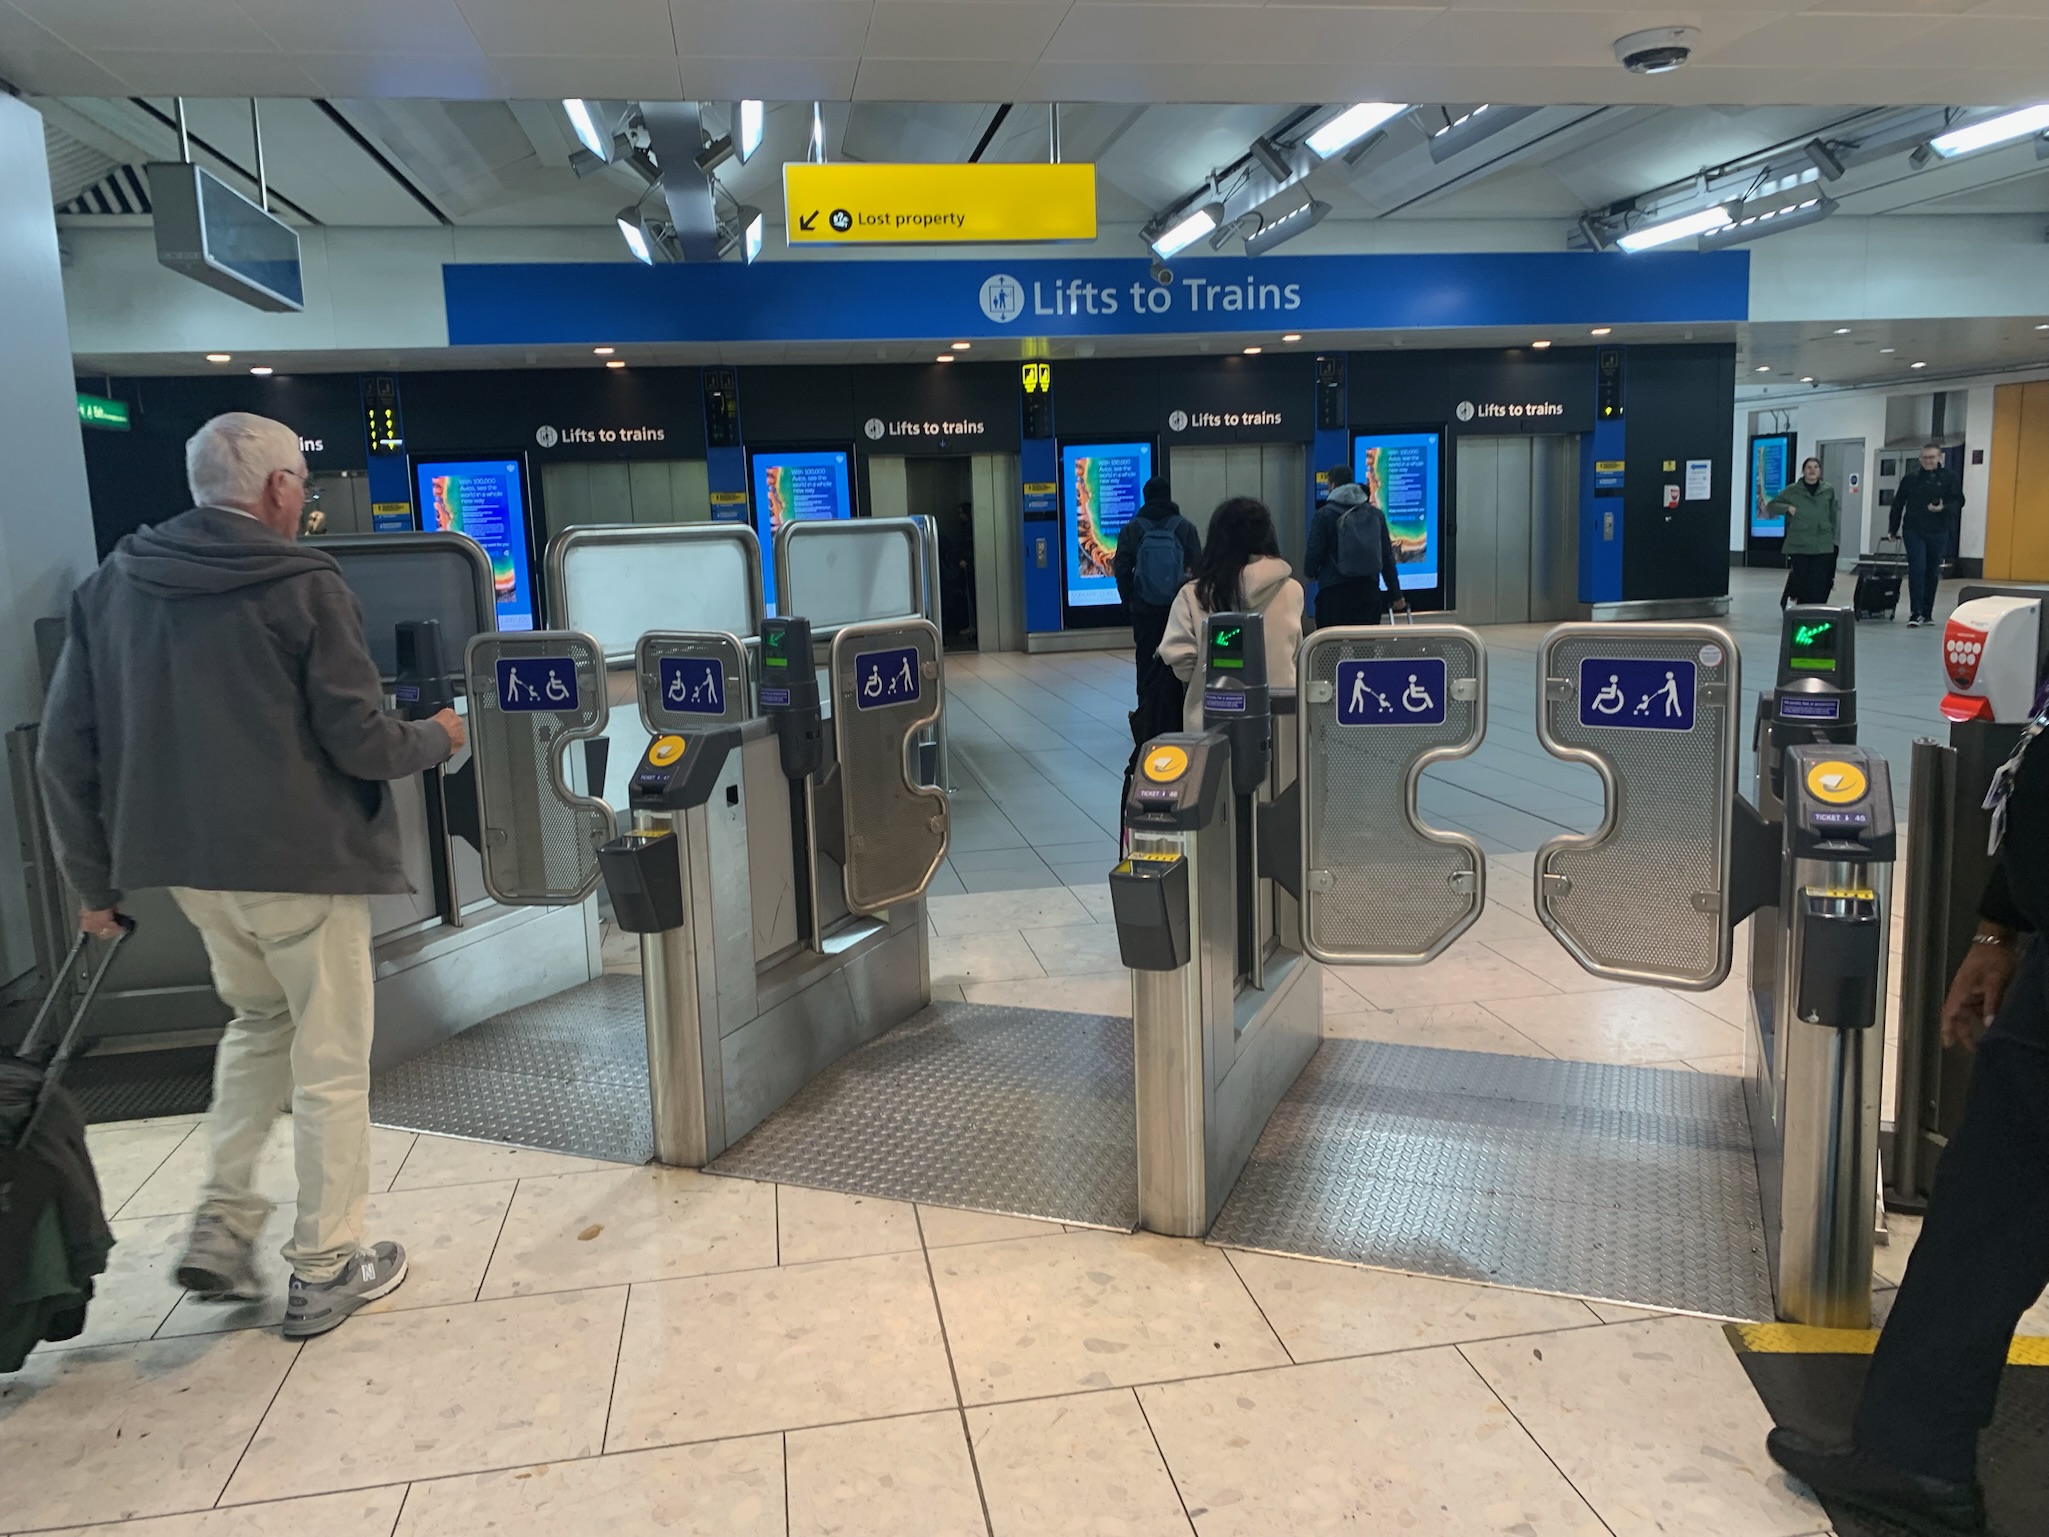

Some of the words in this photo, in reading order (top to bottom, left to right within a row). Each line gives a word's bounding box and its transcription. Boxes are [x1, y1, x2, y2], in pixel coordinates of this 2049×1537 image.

[859, 212, 890, 226] Lost
[896, 214, 965, 228] property
[1034, 279, 1118, 315] Lifts
[1130, 282, 1172, 314] to
[1183, 276, 1301, 312] Trains
[1478, 403, 1506, 417] Lifts
[1509, 404, 1523, 416] to
[1526, 402, 1563, 417] trains
[1192, 412, 1221, 427] Lifts
[1224, 413, 1239, 426] to
[1242, 411, 1282, 426] trains
[562, 428, 595, 443] Lifts
[599, 428, 617, 442] to
[620, 427, 665, 442] trains
[889, 421, 920, 436] Lifts
[923, 422, 940, 435] to
[943, 419, 984, 435] trains
[1815, 813, 1841, 822] TICKET
